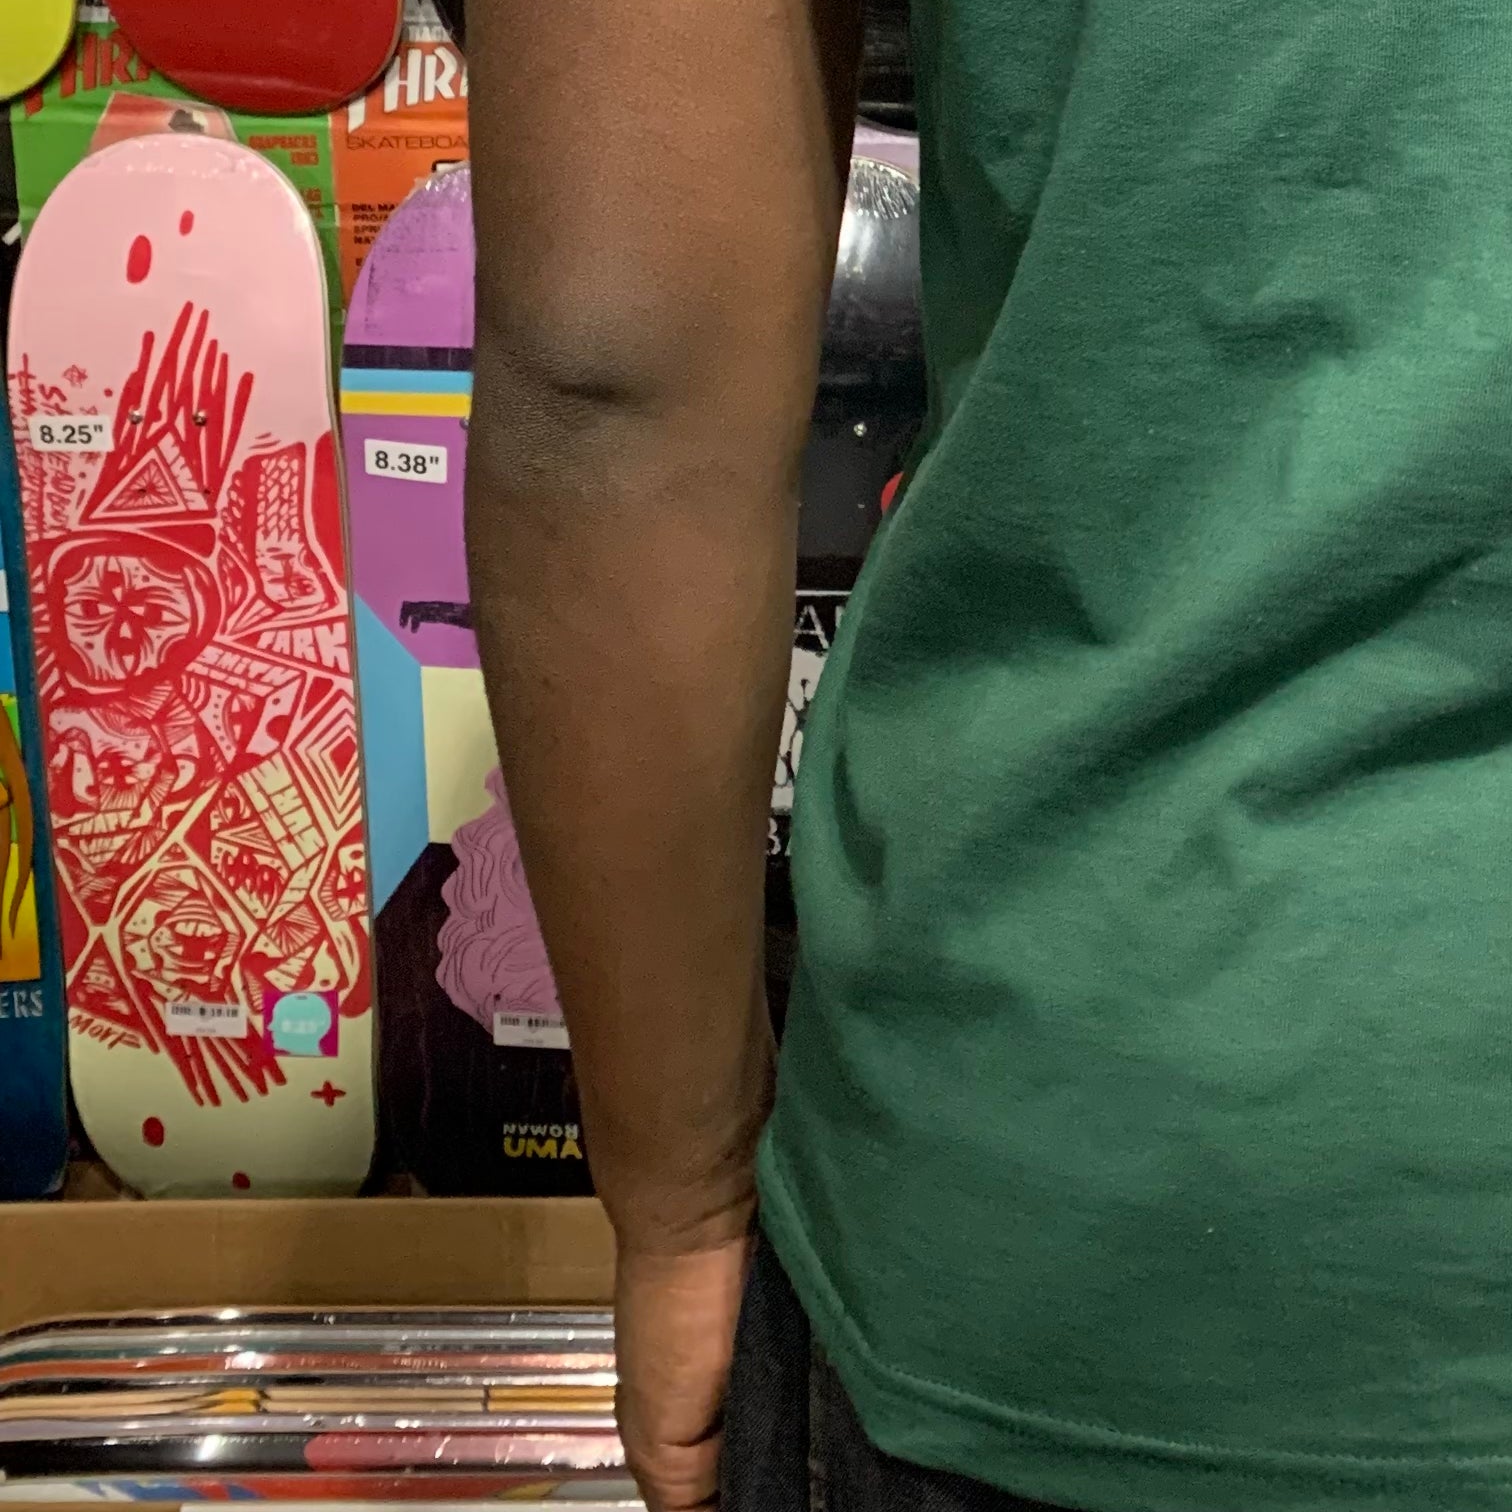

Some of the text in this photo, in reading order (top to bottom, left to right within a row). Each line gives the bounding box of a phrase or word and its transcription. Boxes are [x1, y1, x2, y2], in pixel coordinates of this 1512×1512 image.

[39, 424, 104, 444] 8.25"
[374, 452, 439, 476] 8.38"
[503, 1137, 583, 1160] UMA
